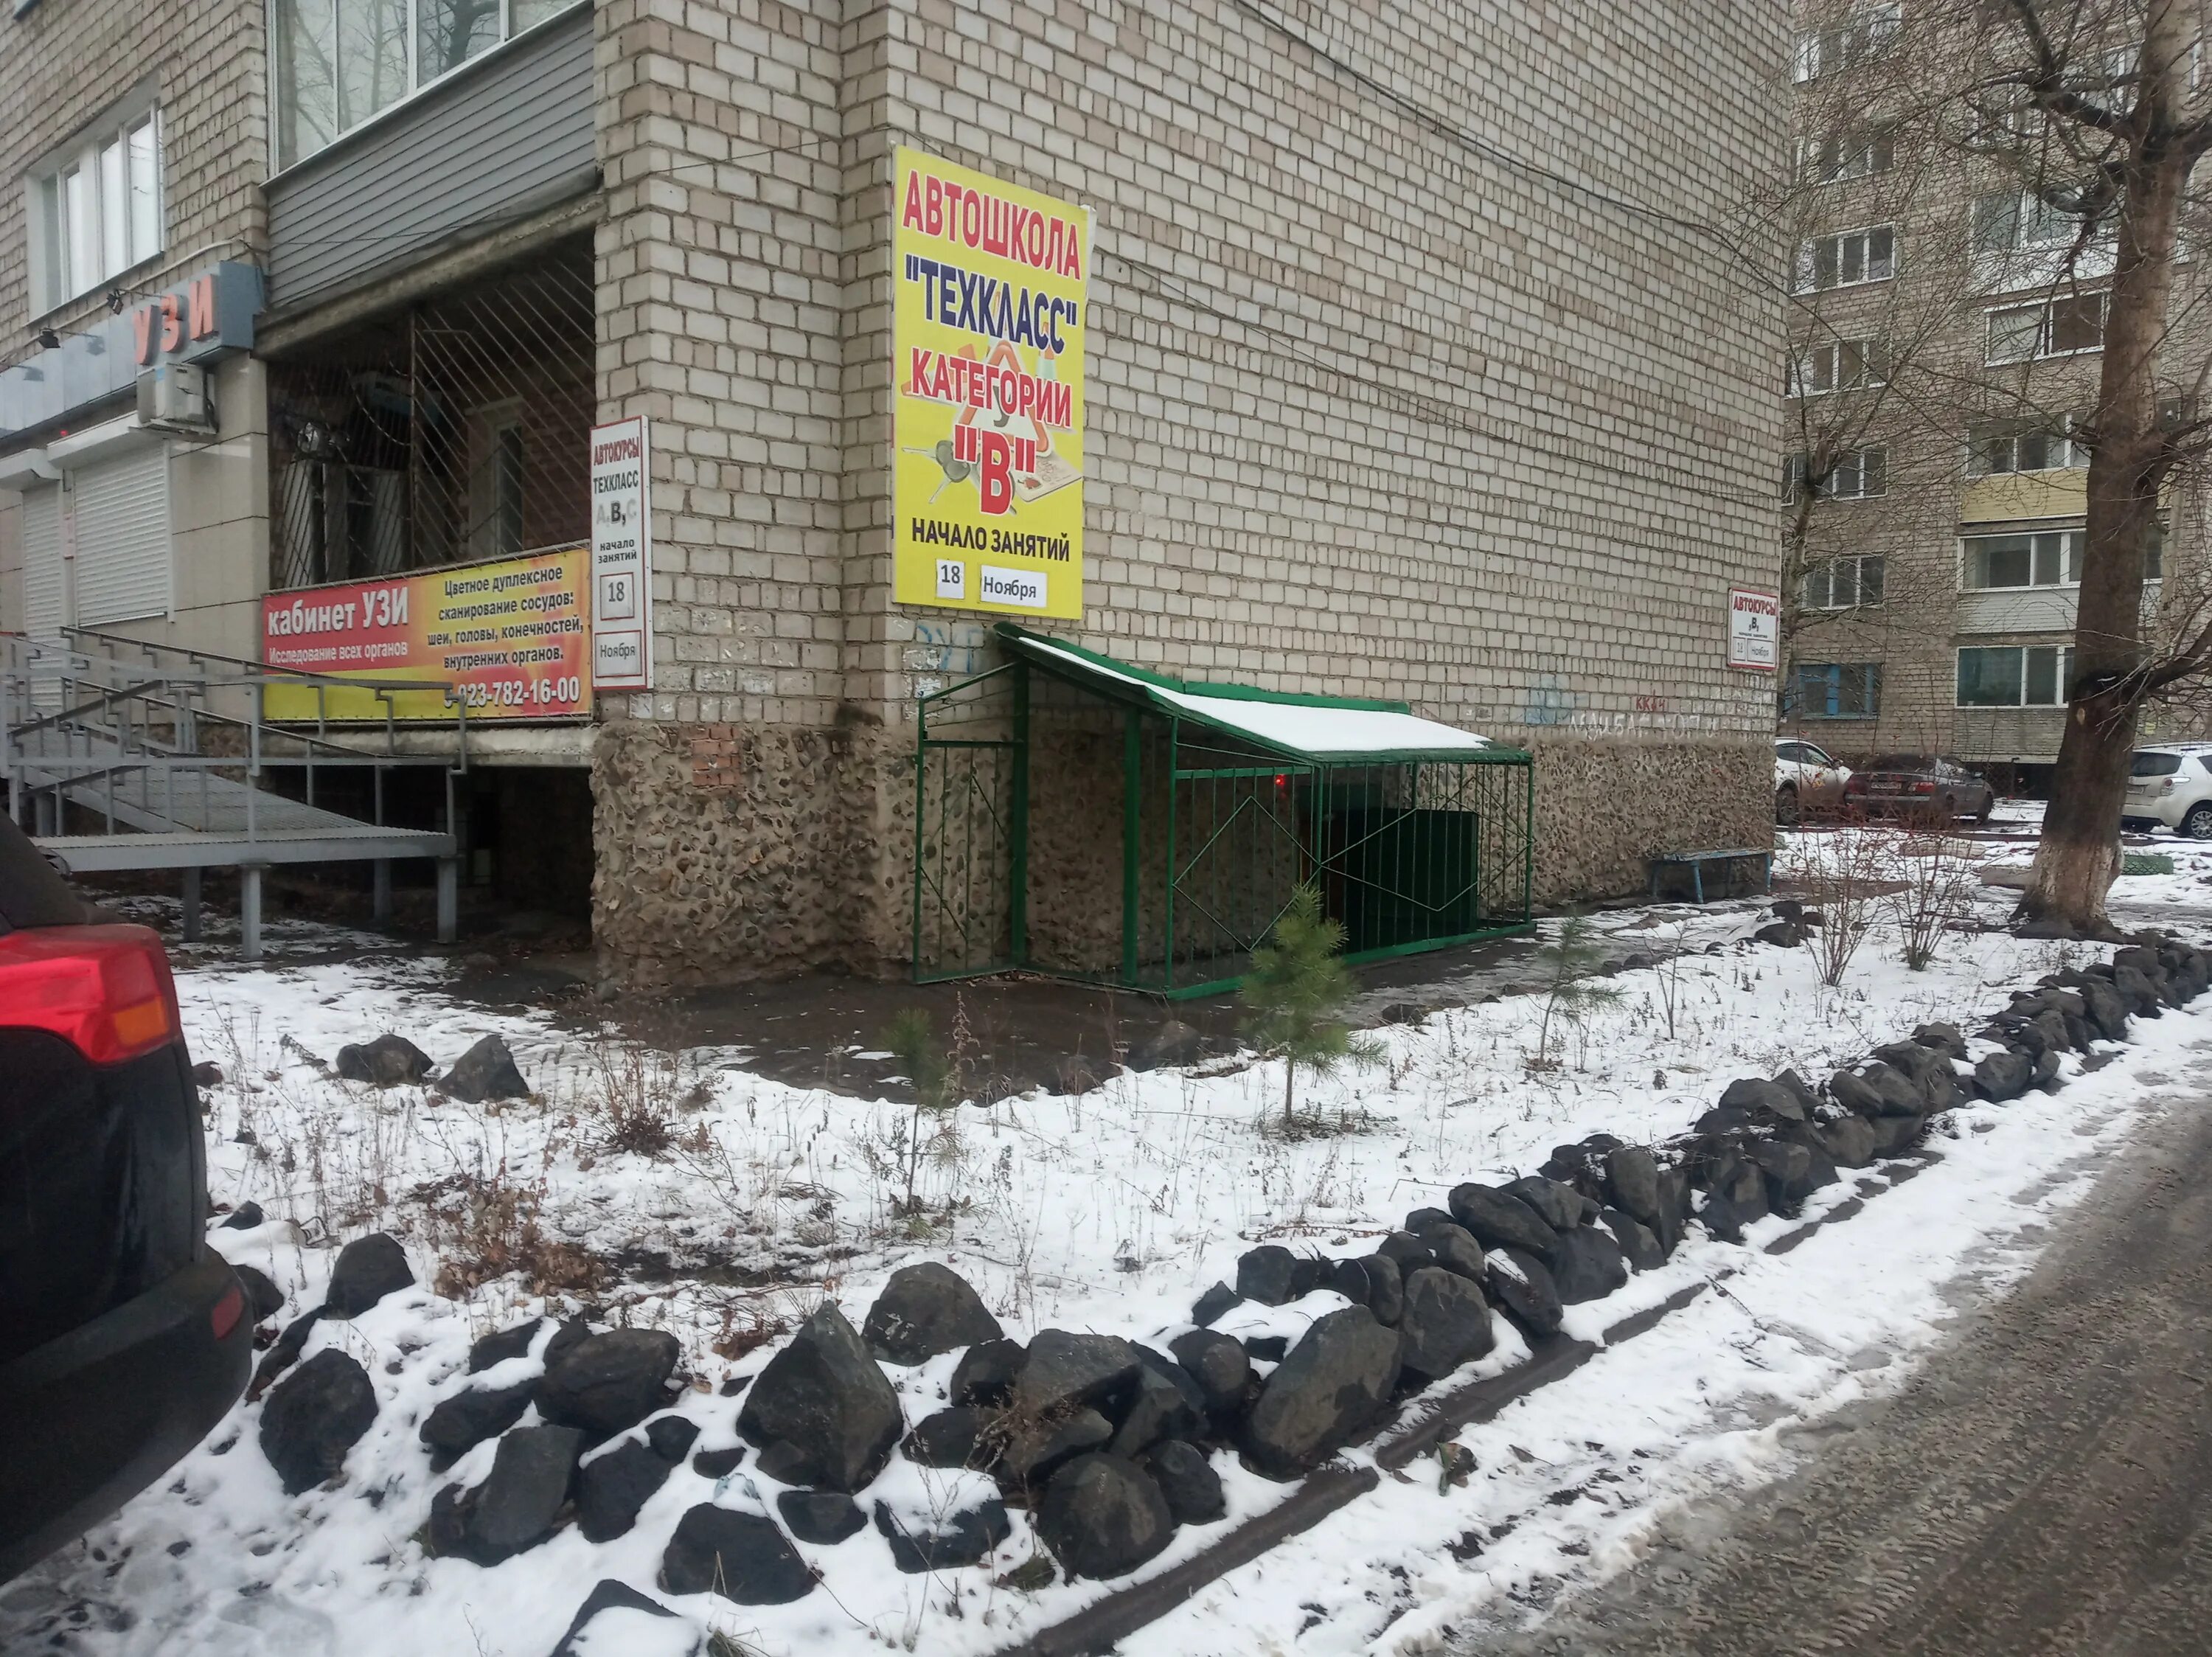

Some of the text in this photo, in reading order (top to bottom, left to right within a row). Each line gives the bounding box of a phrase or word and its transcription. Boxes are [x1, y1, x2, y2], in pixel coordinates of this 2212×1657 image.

[902, 170, 1080, 280] АВТОШКОЛА
[905, 254, 1077, 354] "ТЕХКЛАСС"
[133, 274, 215, 367] УЗИ
[912, 347, 1072, 428] КАТЕГОРИИ
[594, 437, 639, 466] АВТОКУРСЫ
[593, 470, 639, 494] ТЕХКЛАСС
[954, 424, 1037, 515] "В"
[600, 539, 634, 552] начало
[912, 518, 1070, 562] НАЧАЛО ЗАНЯТИЙ
[598, 550, 637, 563] занятий
[445, 566, 563, 599] Цветное дуплексное
[608, 581, 625, 602] 18
[941, 564, 1037, 600] 18 Ноября
[268, 587, 408, 636] кабинет УЗИ
[439, 592, 574, 620] сканирование сосудов:
[1733, 596, 1776, 616] АВТОКУРСЫ
[428, 614, 583, 646] шеи, головы, конечностей,
[269, 642, 408, 666] Исследование всех органов
[444, 647, 563, 671] внутренних органов.
[600, 643, 636, 660] Ноября
